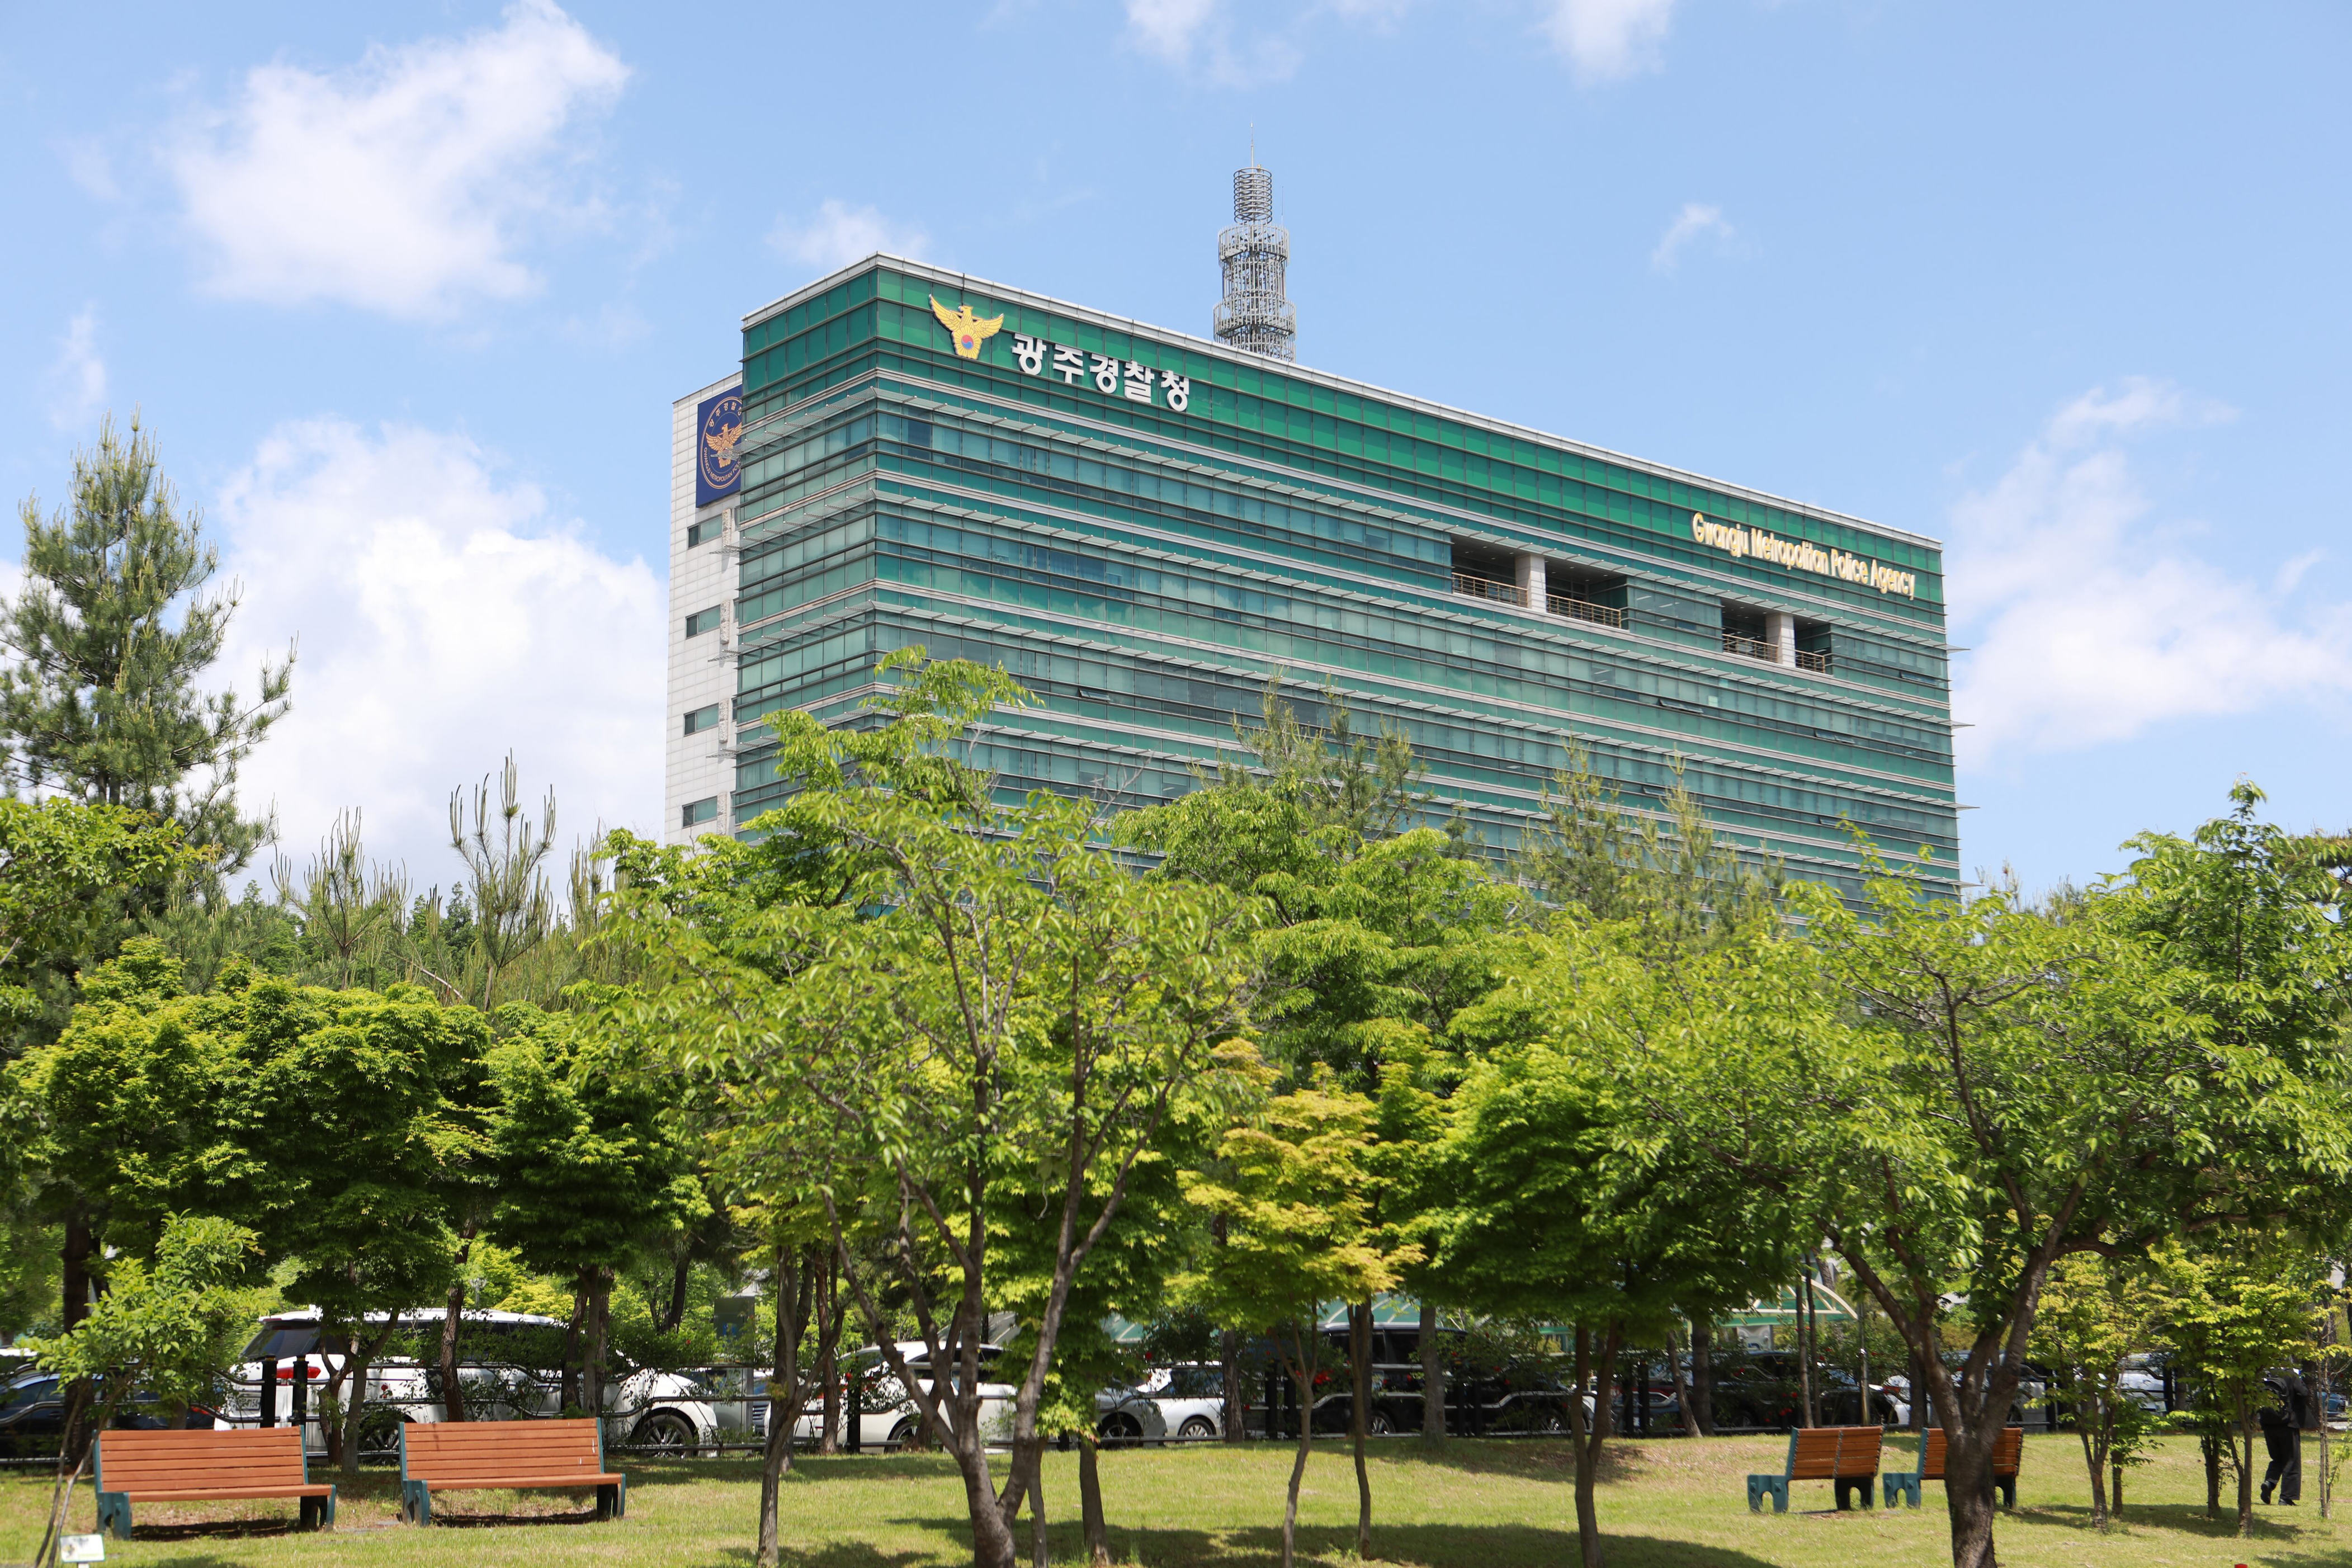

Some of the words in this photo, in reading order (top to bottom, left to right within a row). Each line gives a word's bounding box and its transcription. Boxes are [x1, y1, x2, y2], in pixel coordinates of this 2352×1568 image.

[1012, 333, 1189, 412] 광주경찰청
[1693, 512, 1749, 558] Gwangju
[1751, 527, 1829, 575] Metropolitan
[1831, 548, 1868, 584] Police
[1870, 559, 1915, 601] Agency
